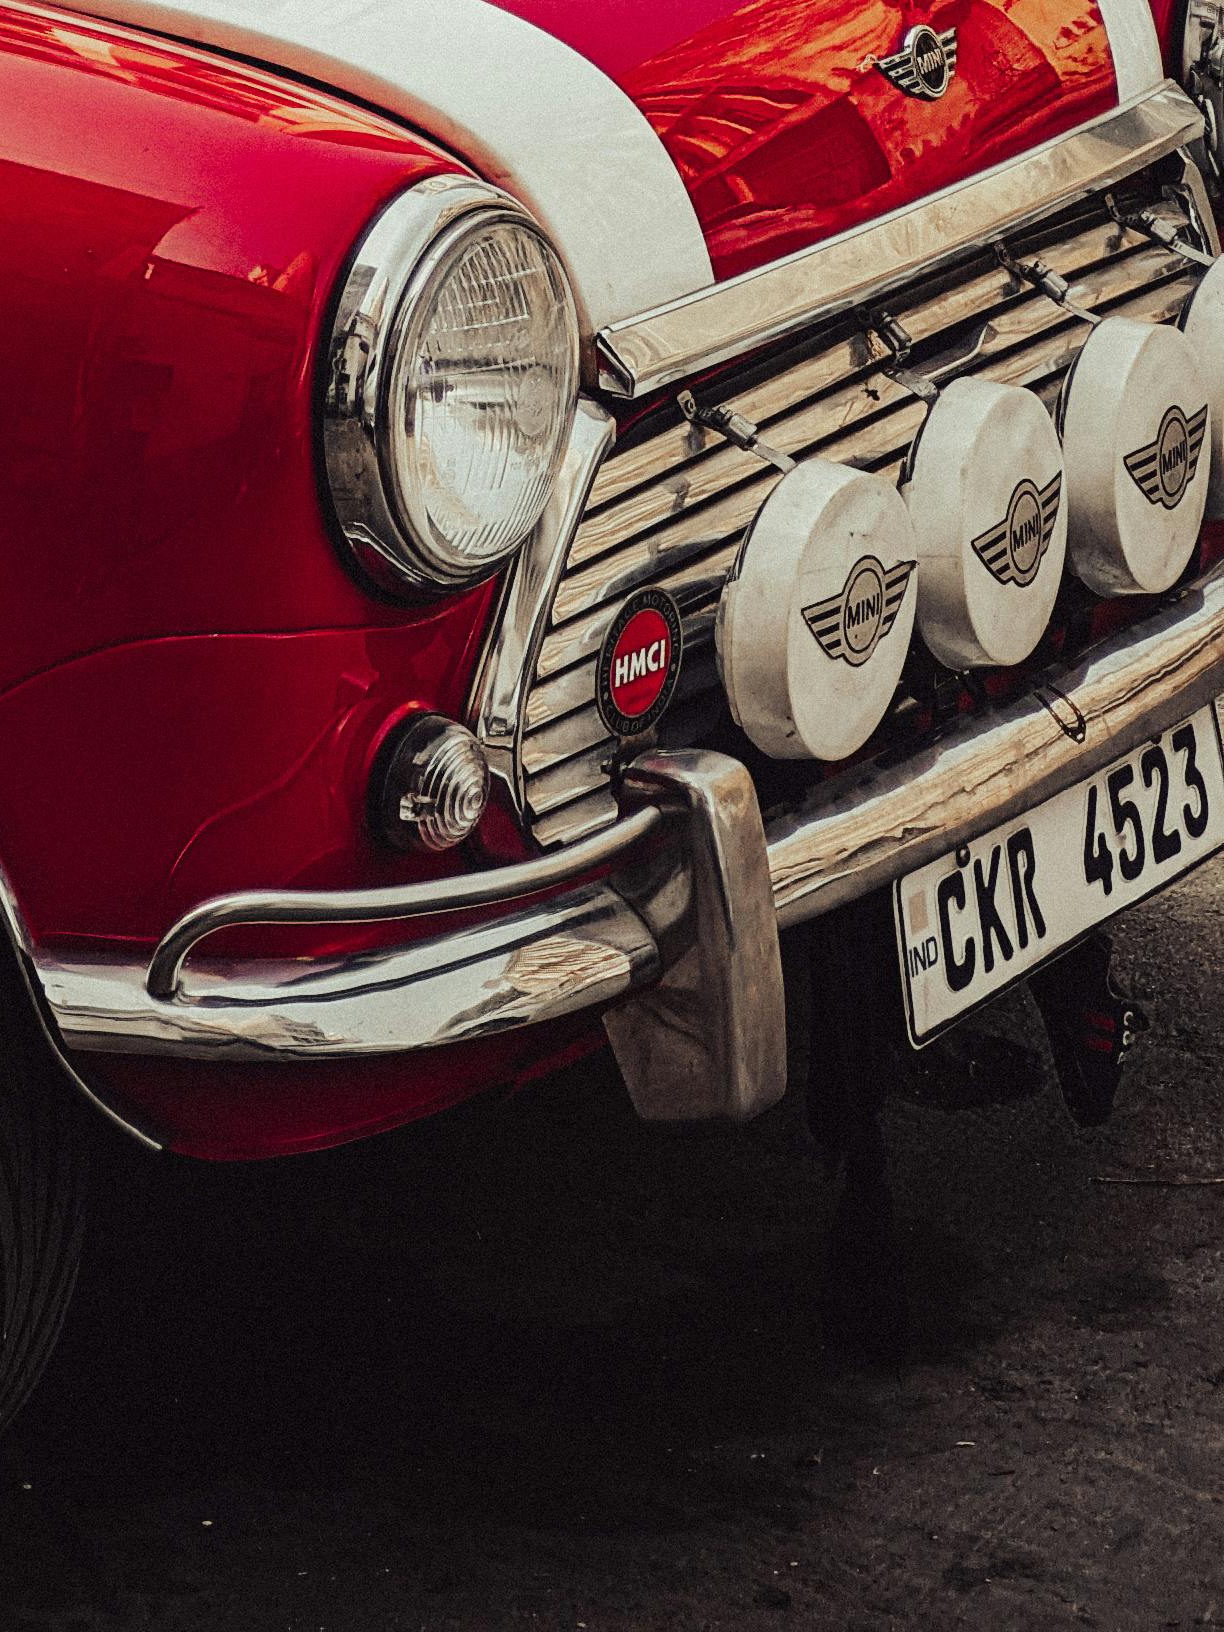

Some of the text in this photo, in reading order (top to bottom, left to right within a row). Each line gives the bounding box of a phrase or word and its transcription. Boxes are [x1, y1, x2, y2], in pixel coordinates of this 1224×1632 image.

[916, 48, 943, 75] MIN
[1162, 440, 1187, 475] MINI
[1012, 513, 1039, 553] MINI
[847, 593, 880, 629] MINI
[615, 639, 666, 688] HMCI
[937, 723, 1209, 992] CKR 4523
[908, 936, 939, 978] IND
